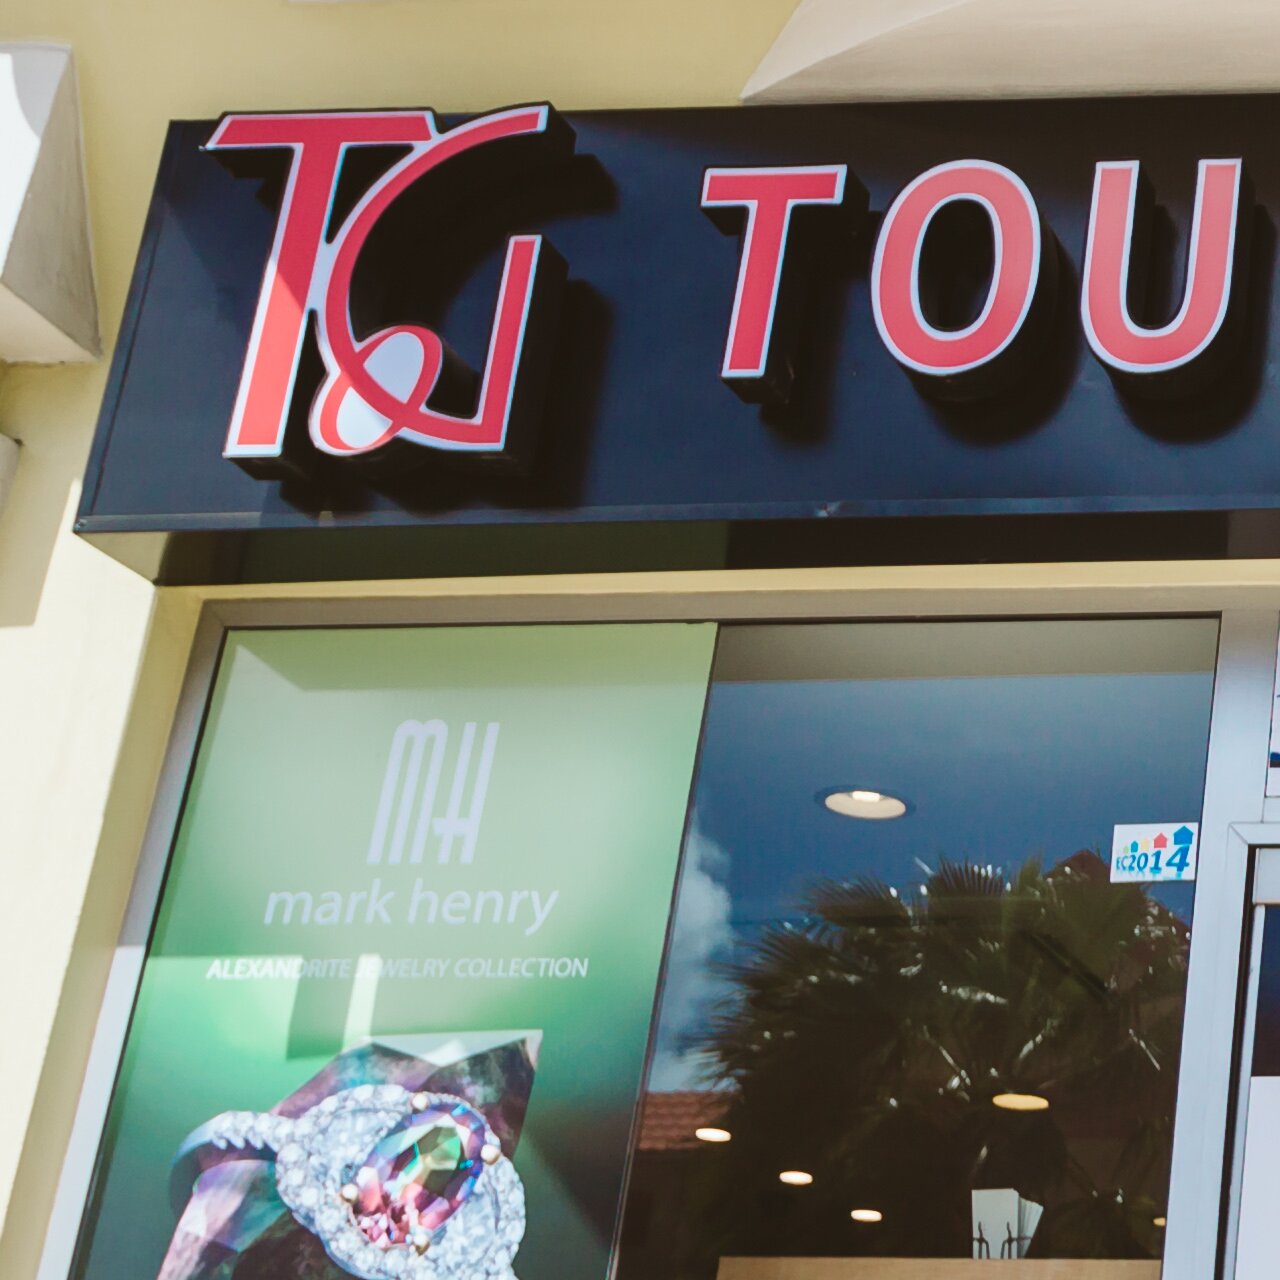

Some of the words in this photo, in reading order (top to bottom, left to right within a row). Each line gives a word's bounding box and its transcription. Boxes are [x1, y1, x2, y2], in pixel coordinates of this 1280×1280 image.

[263, 878, 396, 926] mark
[408, 878, 560, 936] henry
[206, 957, 351, 981] ALEXANDRITE
[454, 957, 589, 979] COLLECTION
